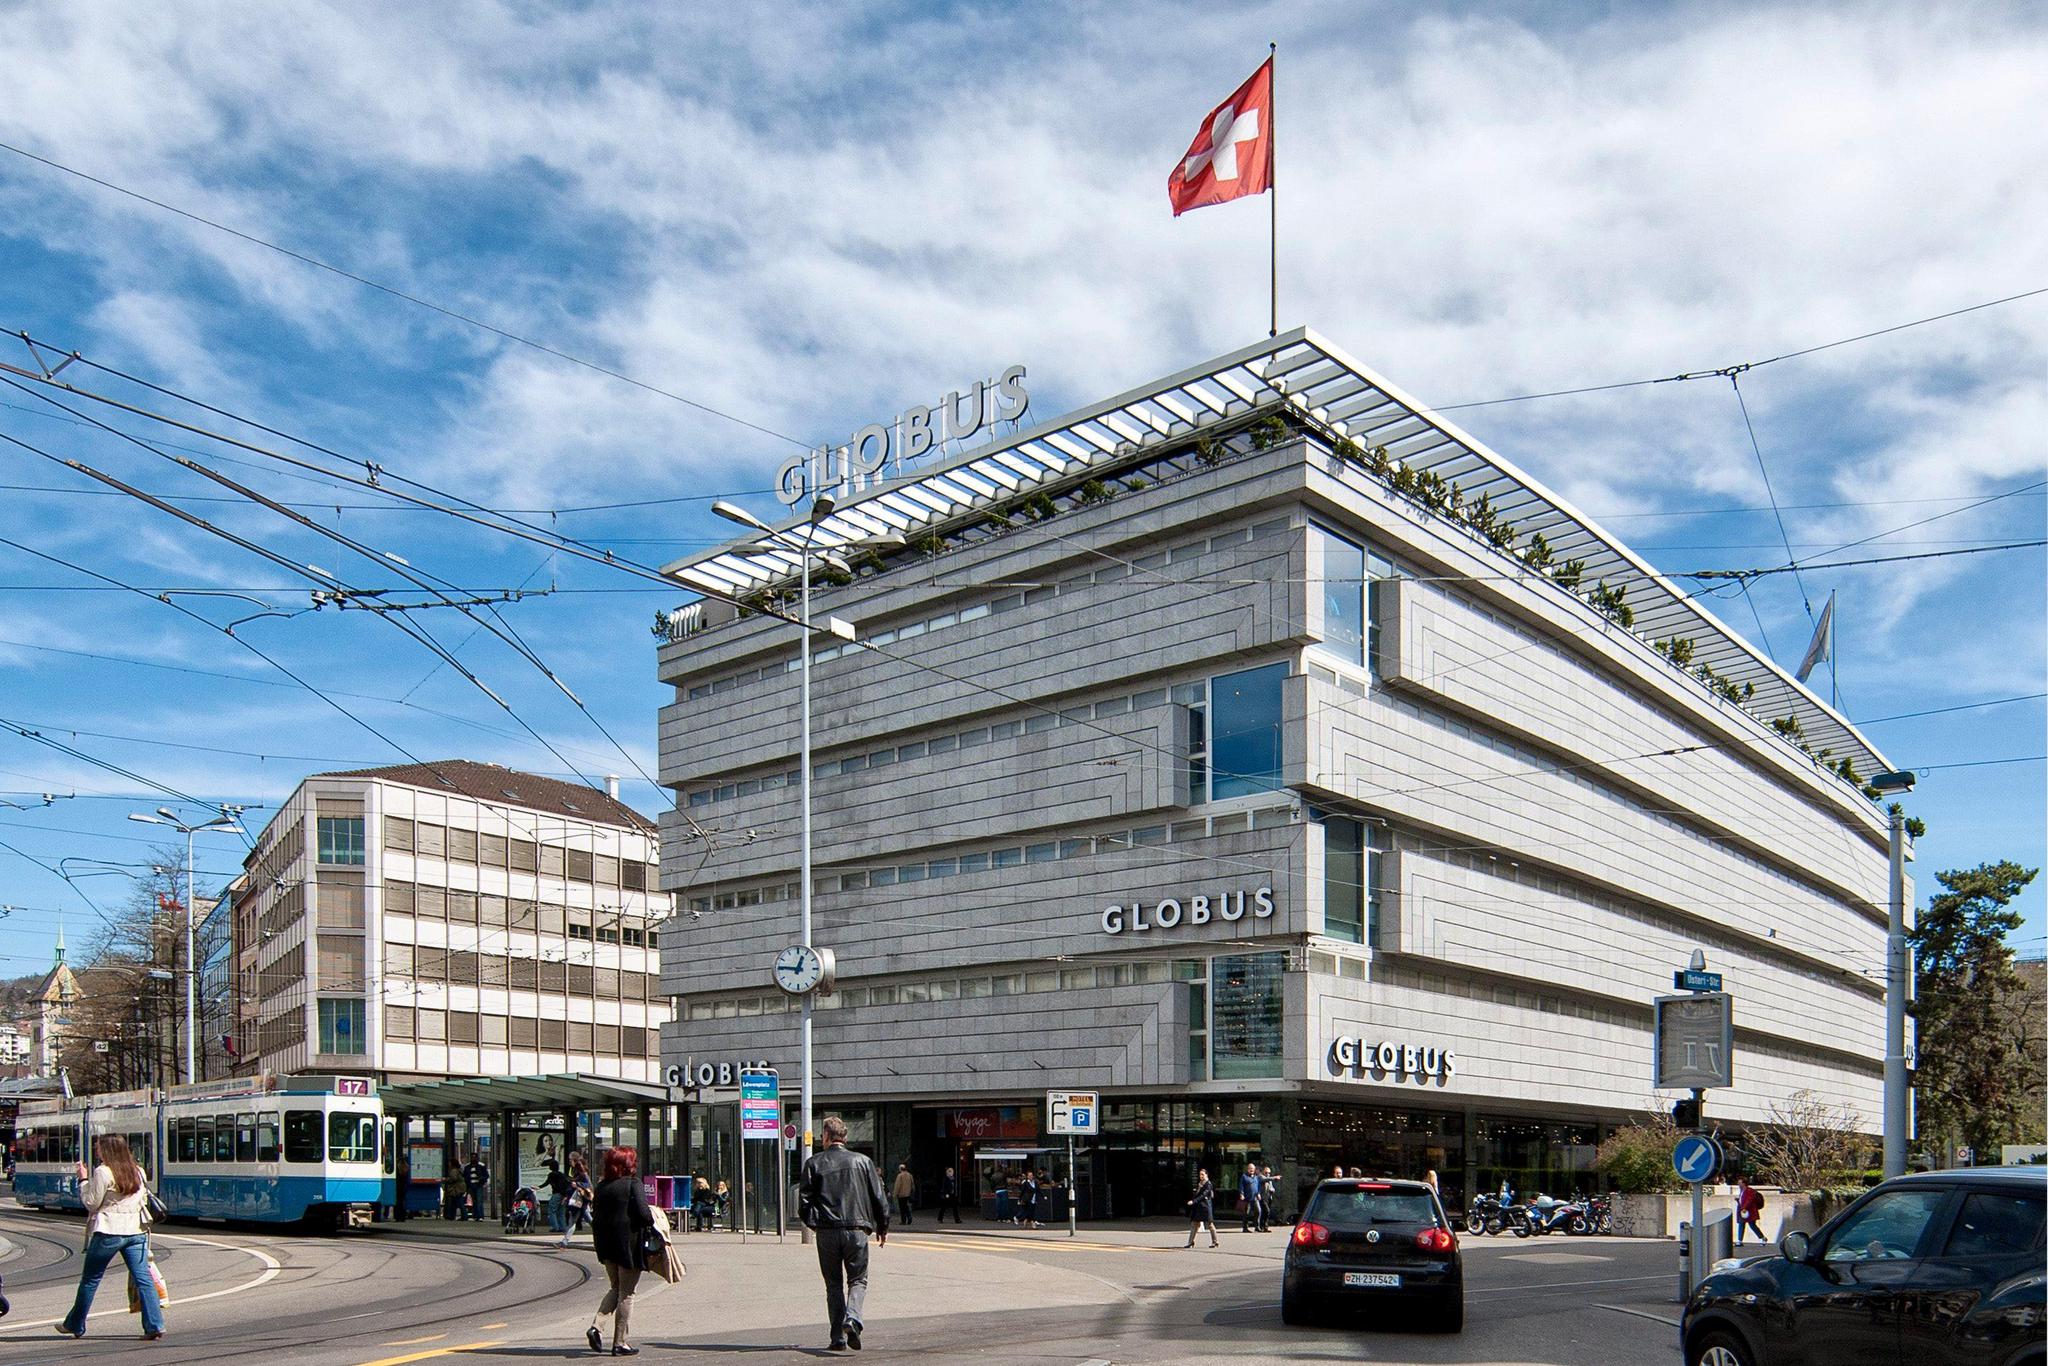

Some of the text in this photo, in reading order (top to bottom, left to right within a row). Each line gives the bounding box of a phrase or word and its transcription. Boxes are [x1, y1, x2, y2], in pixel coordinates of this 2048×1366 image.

[775, 365, 1027, 505] GLOBUS
[1101, 887, 1274, 934] GLOBUS
[1335, 1035, 1456, 1077] GLOBUS
[343, 1081, 362, 1094] 17
[953, 1110, 992, 1136] Voyage
